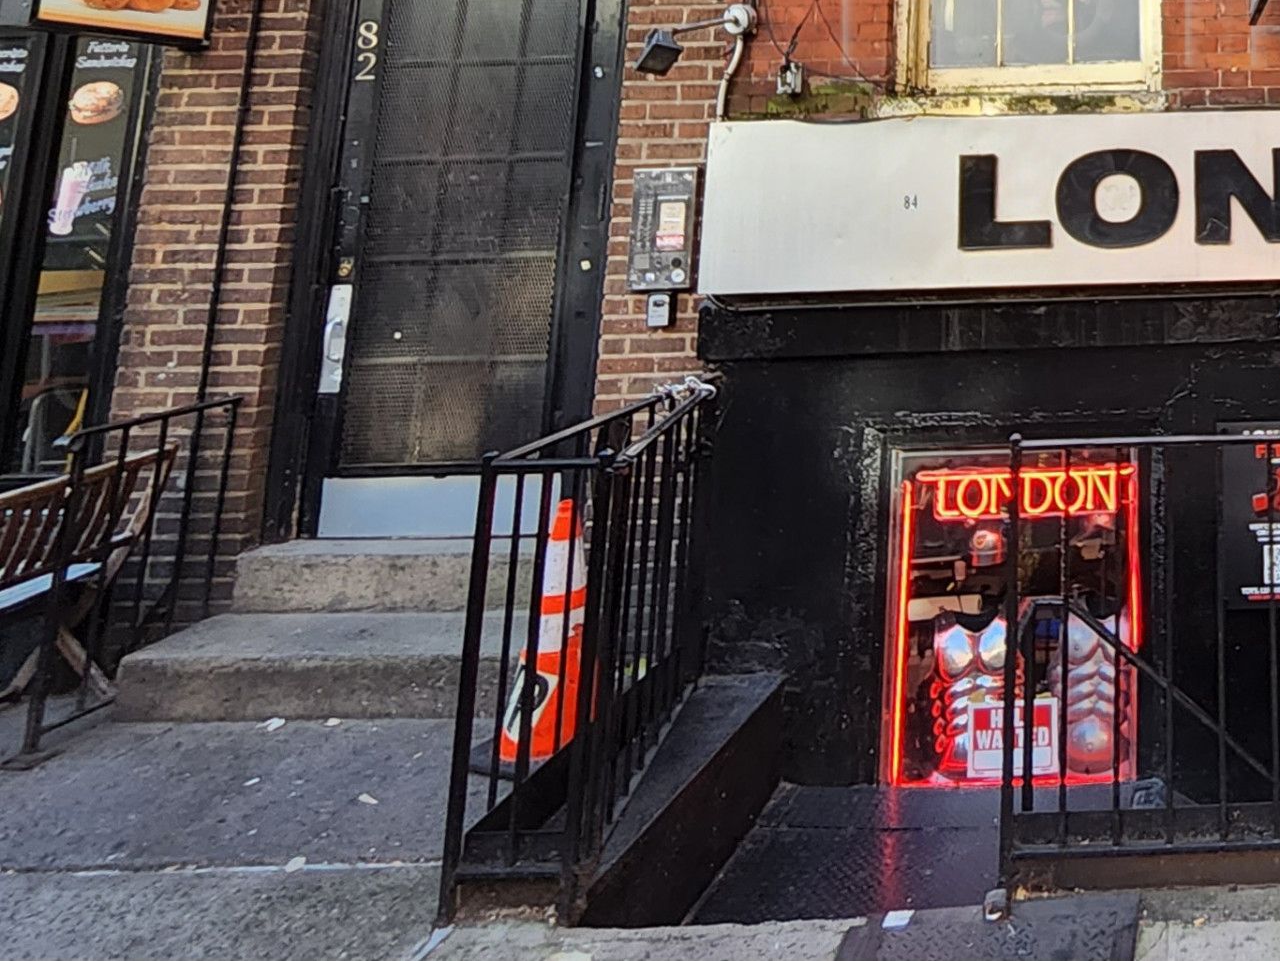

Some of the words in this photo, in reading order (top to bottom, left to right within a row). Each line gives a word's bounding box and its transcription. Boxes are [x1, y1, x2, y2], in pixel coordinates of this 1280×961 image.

[903, 195, 918, 210] 84
[937, 472, 1117, 518] LONDON
[976, 726, 1050, 750] WATD
